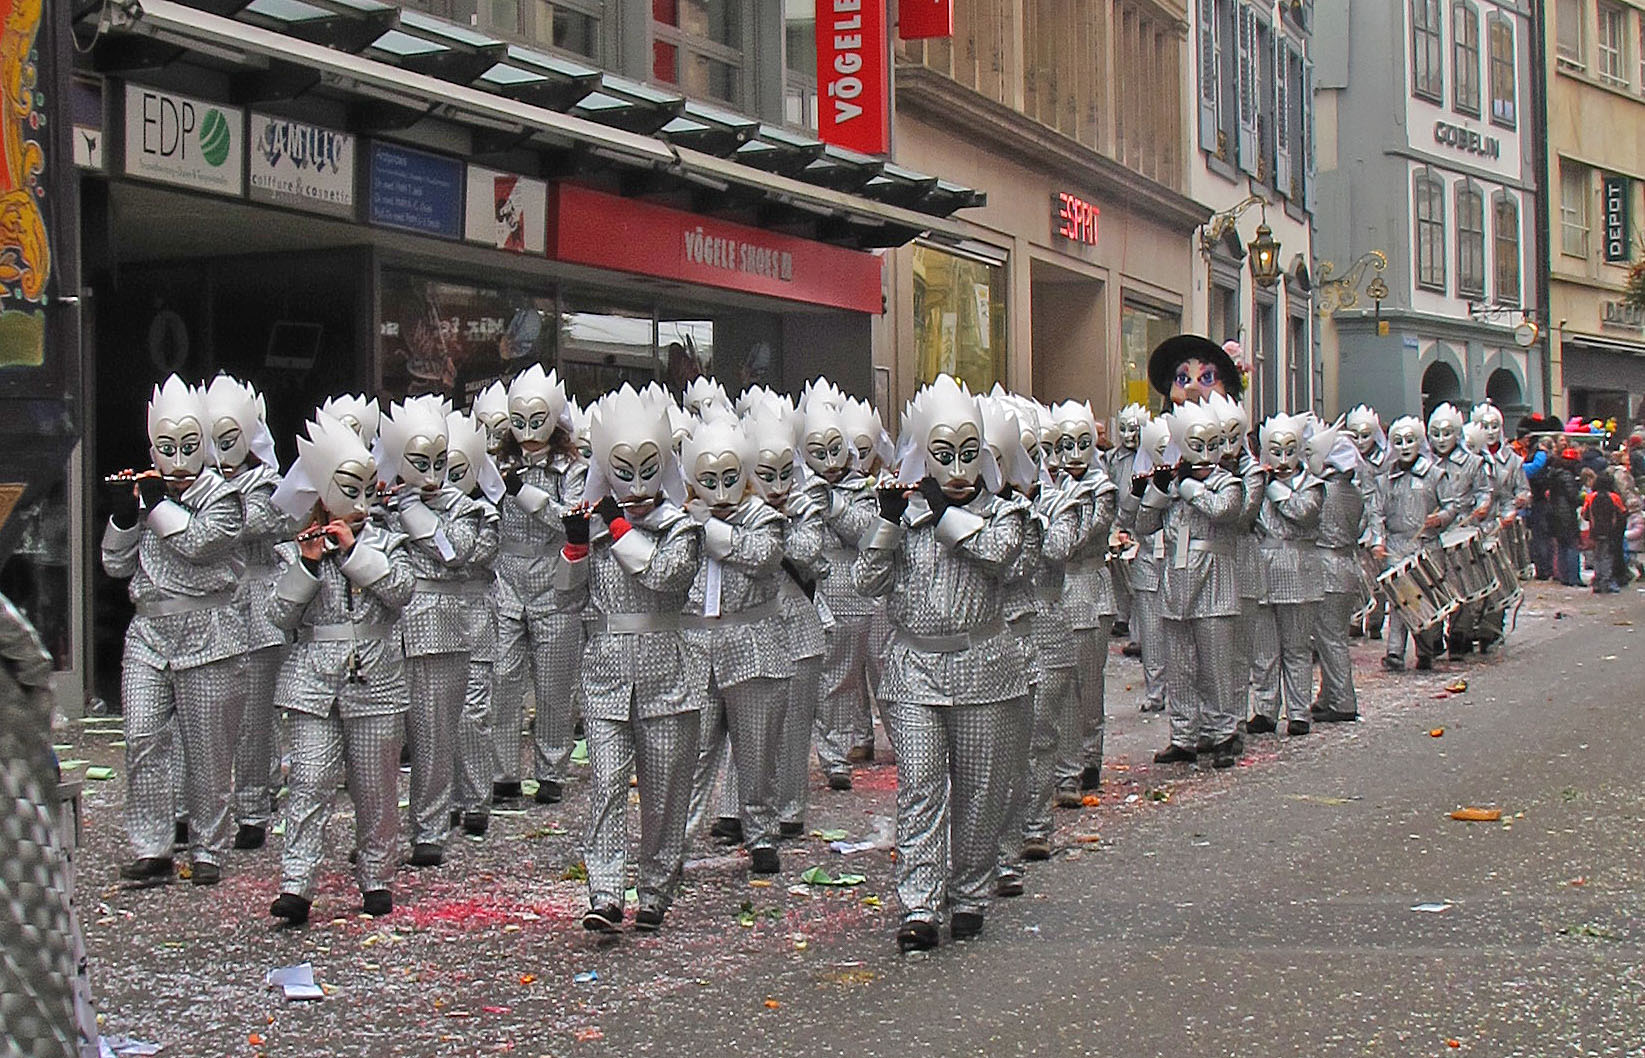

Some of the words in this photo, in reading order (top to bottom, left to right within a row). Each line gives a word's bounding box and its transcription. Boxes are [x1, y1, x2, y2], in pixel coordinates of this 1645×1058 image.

[143, 92, 195, 160] EDP
[1433, 120, 1500, 161] GOBELIN
[1059, 191, 1100, 246] ESPRIT
[1608, 184, 1622, 257] DEPOT
[740, 242, 780, 279] SHOES
